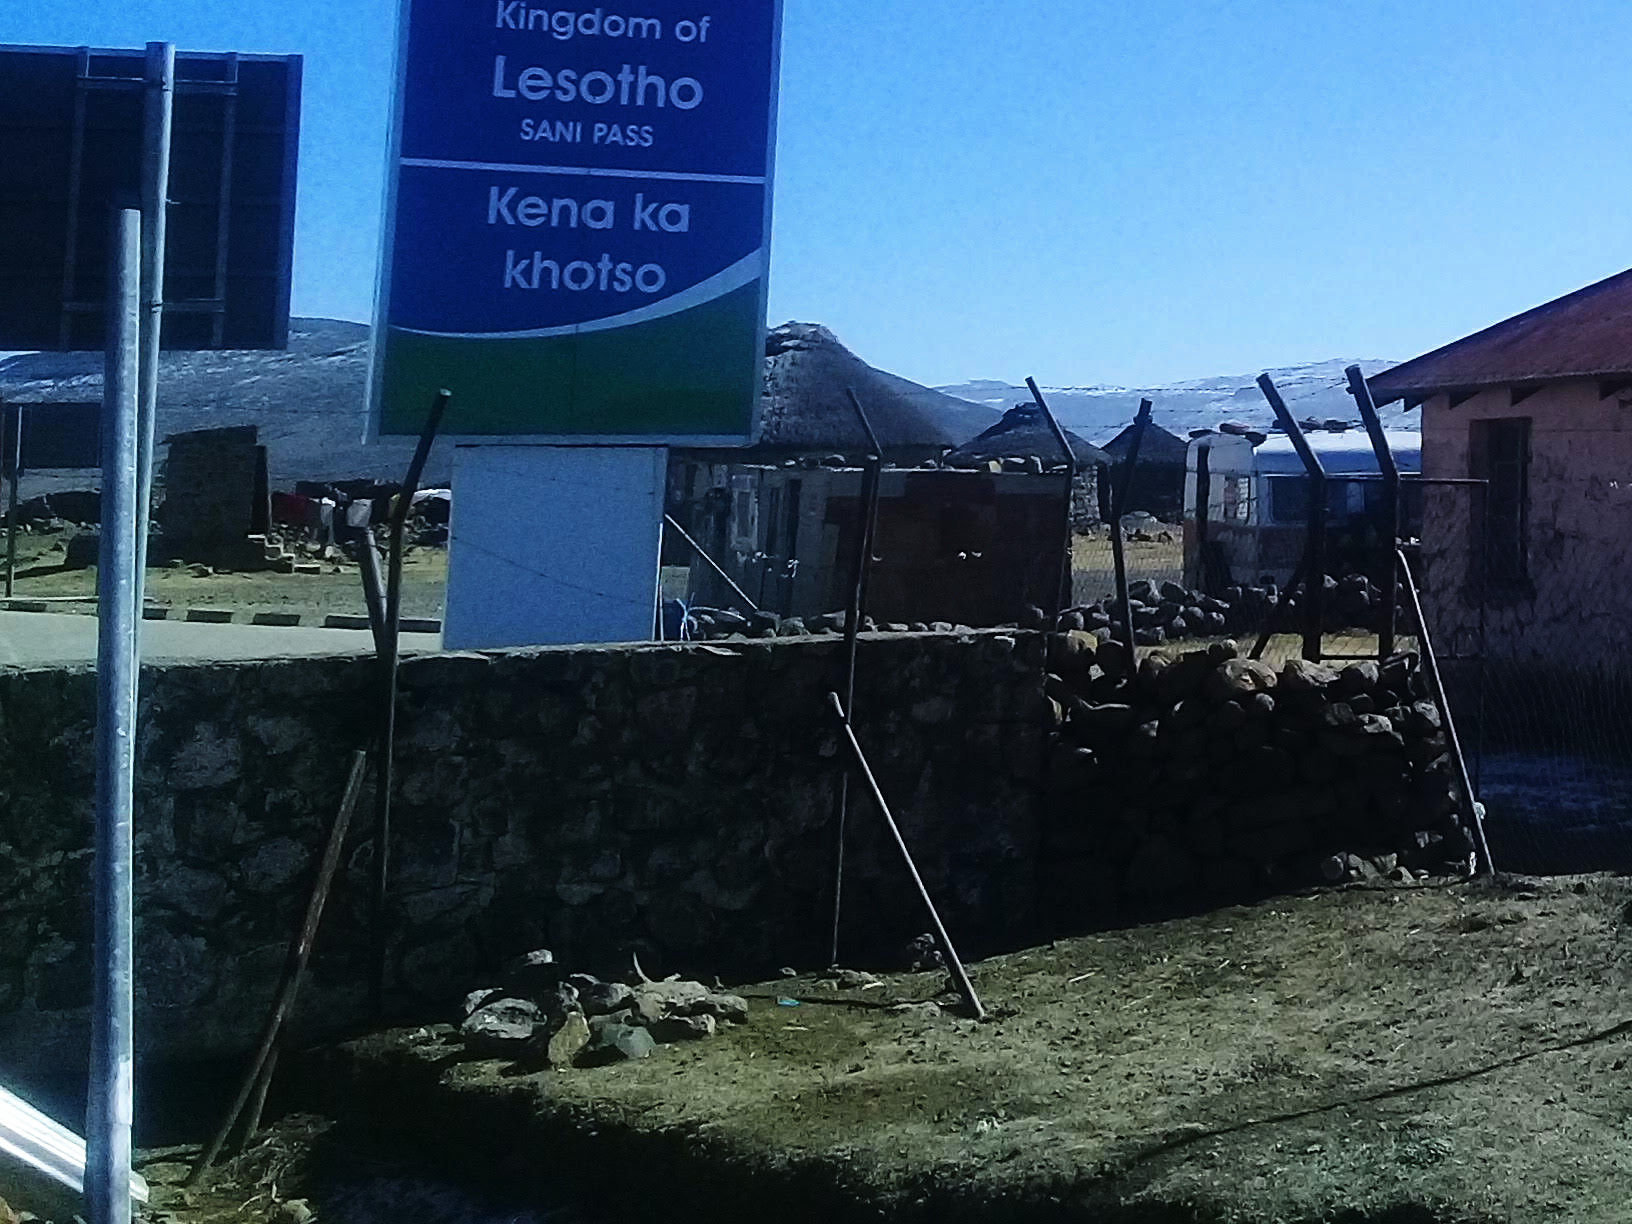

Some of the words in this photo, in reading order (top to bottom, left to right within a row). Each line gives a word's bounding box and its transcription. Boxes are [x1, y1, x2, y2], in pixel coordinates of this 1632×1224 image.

[496, 0, 661, 41] Kingdom
[675, 15, 711, 43] of
[493, 55, 704, 110] Lesotho
[520, 118, 582, 143] SANI
[593, 122, 654, 148] PASS
[488, 186, 614, 230] Kena
[633, 192, 690, 233] ka
[504, 249, 667, 294] khotso
